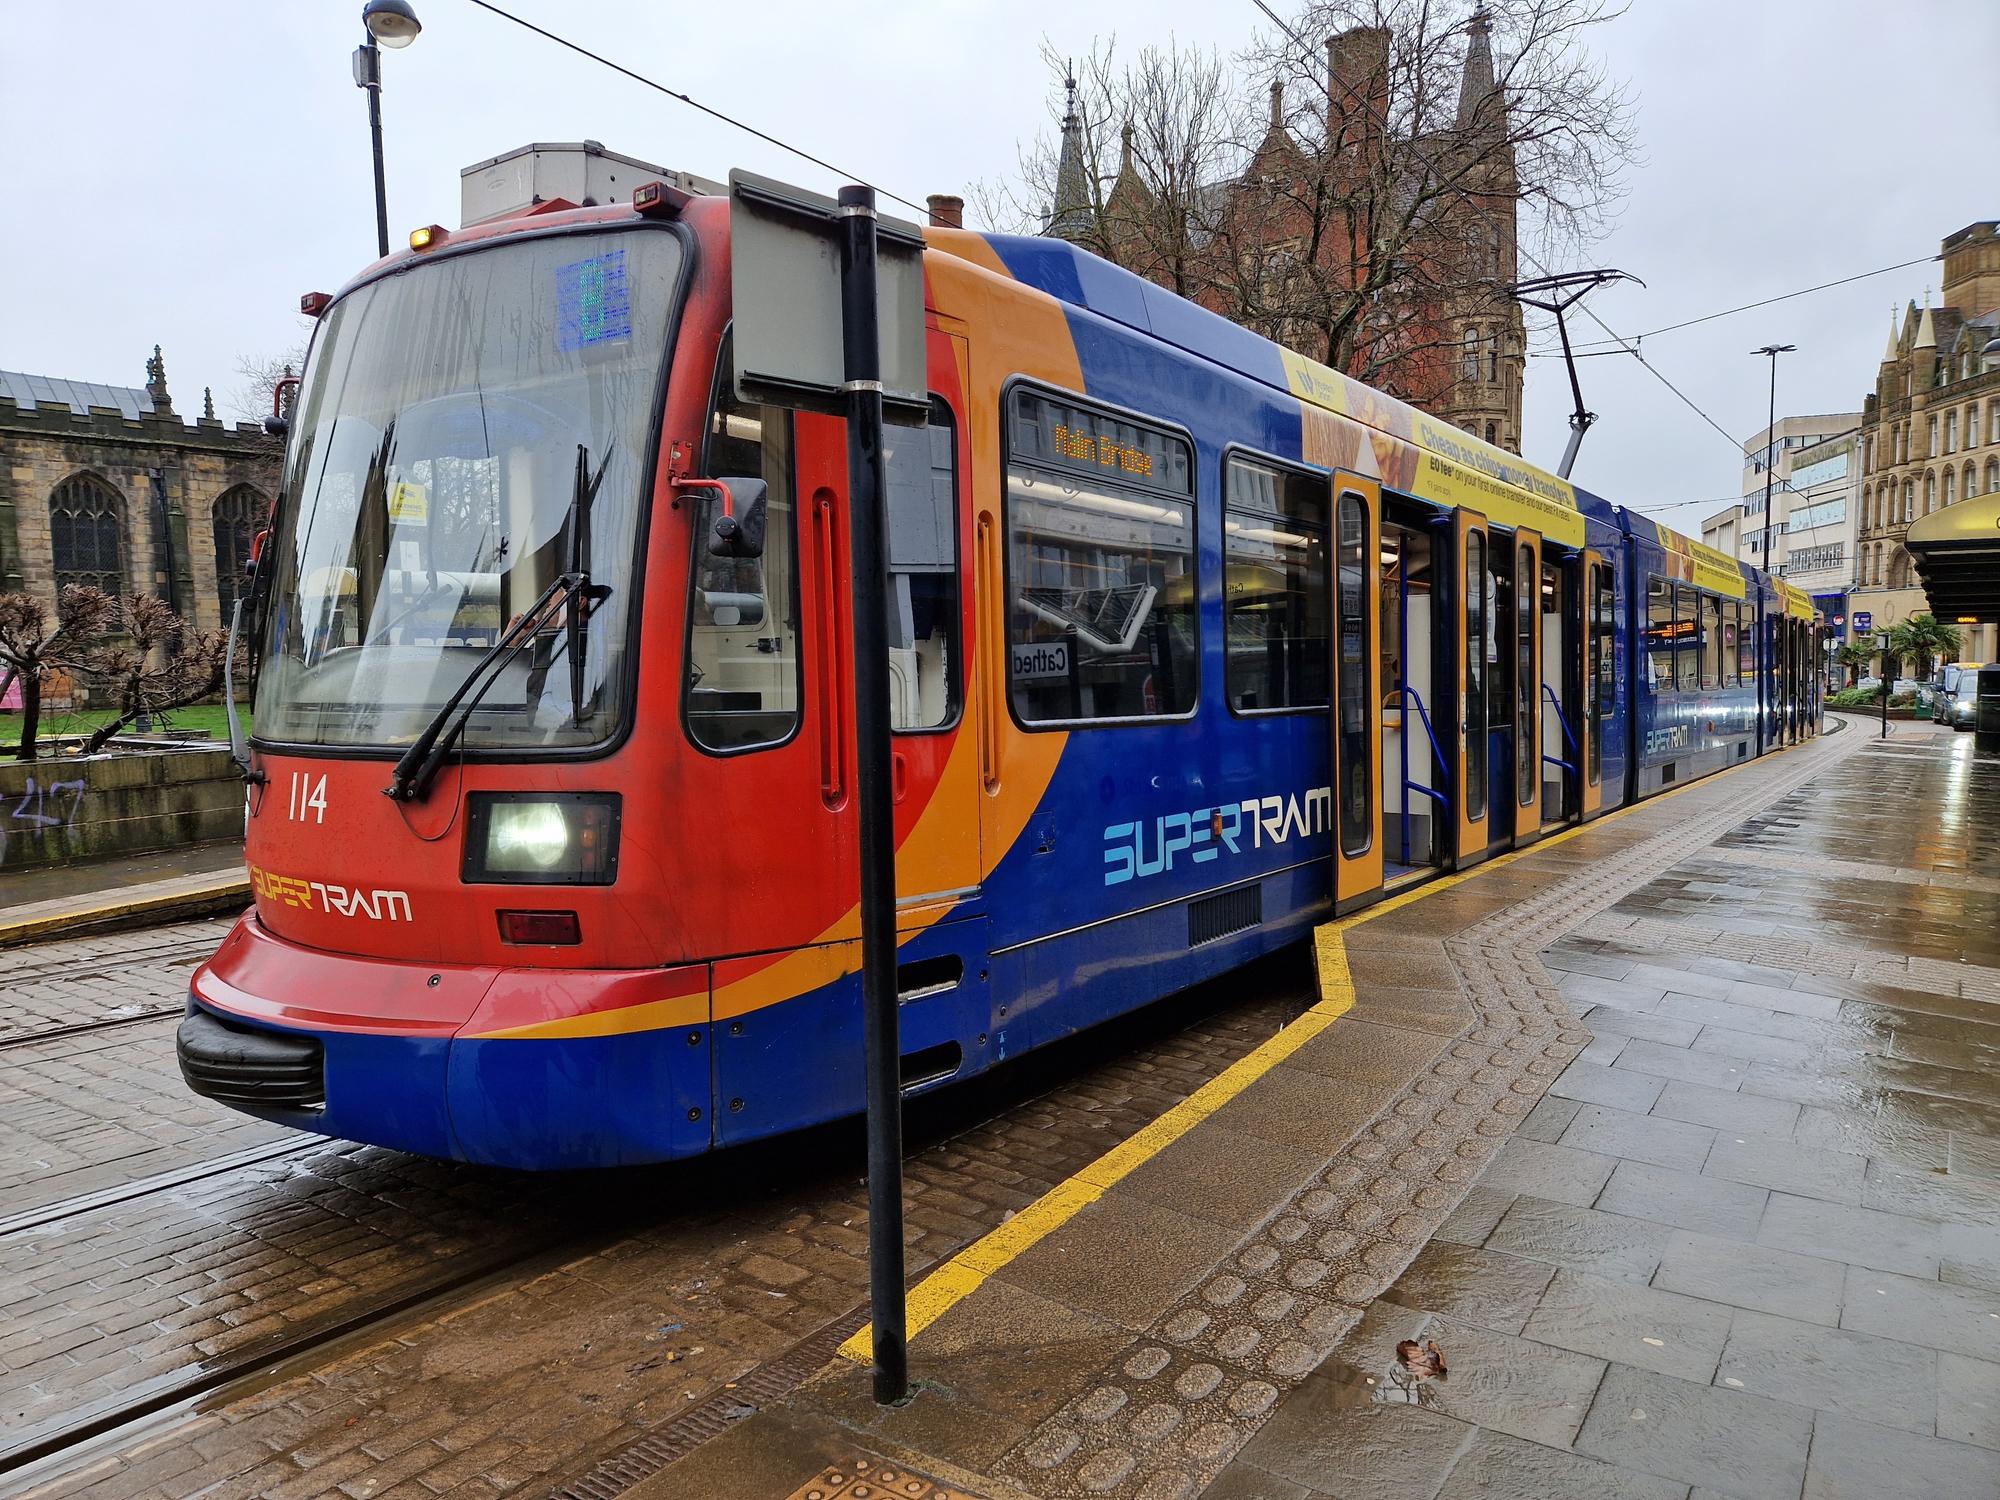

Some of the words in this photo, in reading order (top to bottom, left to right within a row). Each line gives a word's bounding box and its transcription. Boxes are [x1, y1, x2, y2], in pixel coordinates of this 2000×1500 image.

[1100, 434, 1153, 478] Bridge
[1421, 423, 1461, 461] Cheap
[1461, 448, 1475, 468] as
[1455, 469, 1463, 482] on
[1464, 473, 1477, 488] your
[1477, 476, 1489, 492] first
[1647, 724, 1688, 755] SUPERTRAM
[288, 771, 328, 825] 114
[1103, 786, 1332, 887] SUPERTRAM
[252, 866, 414, 922] SUPERTRAM
